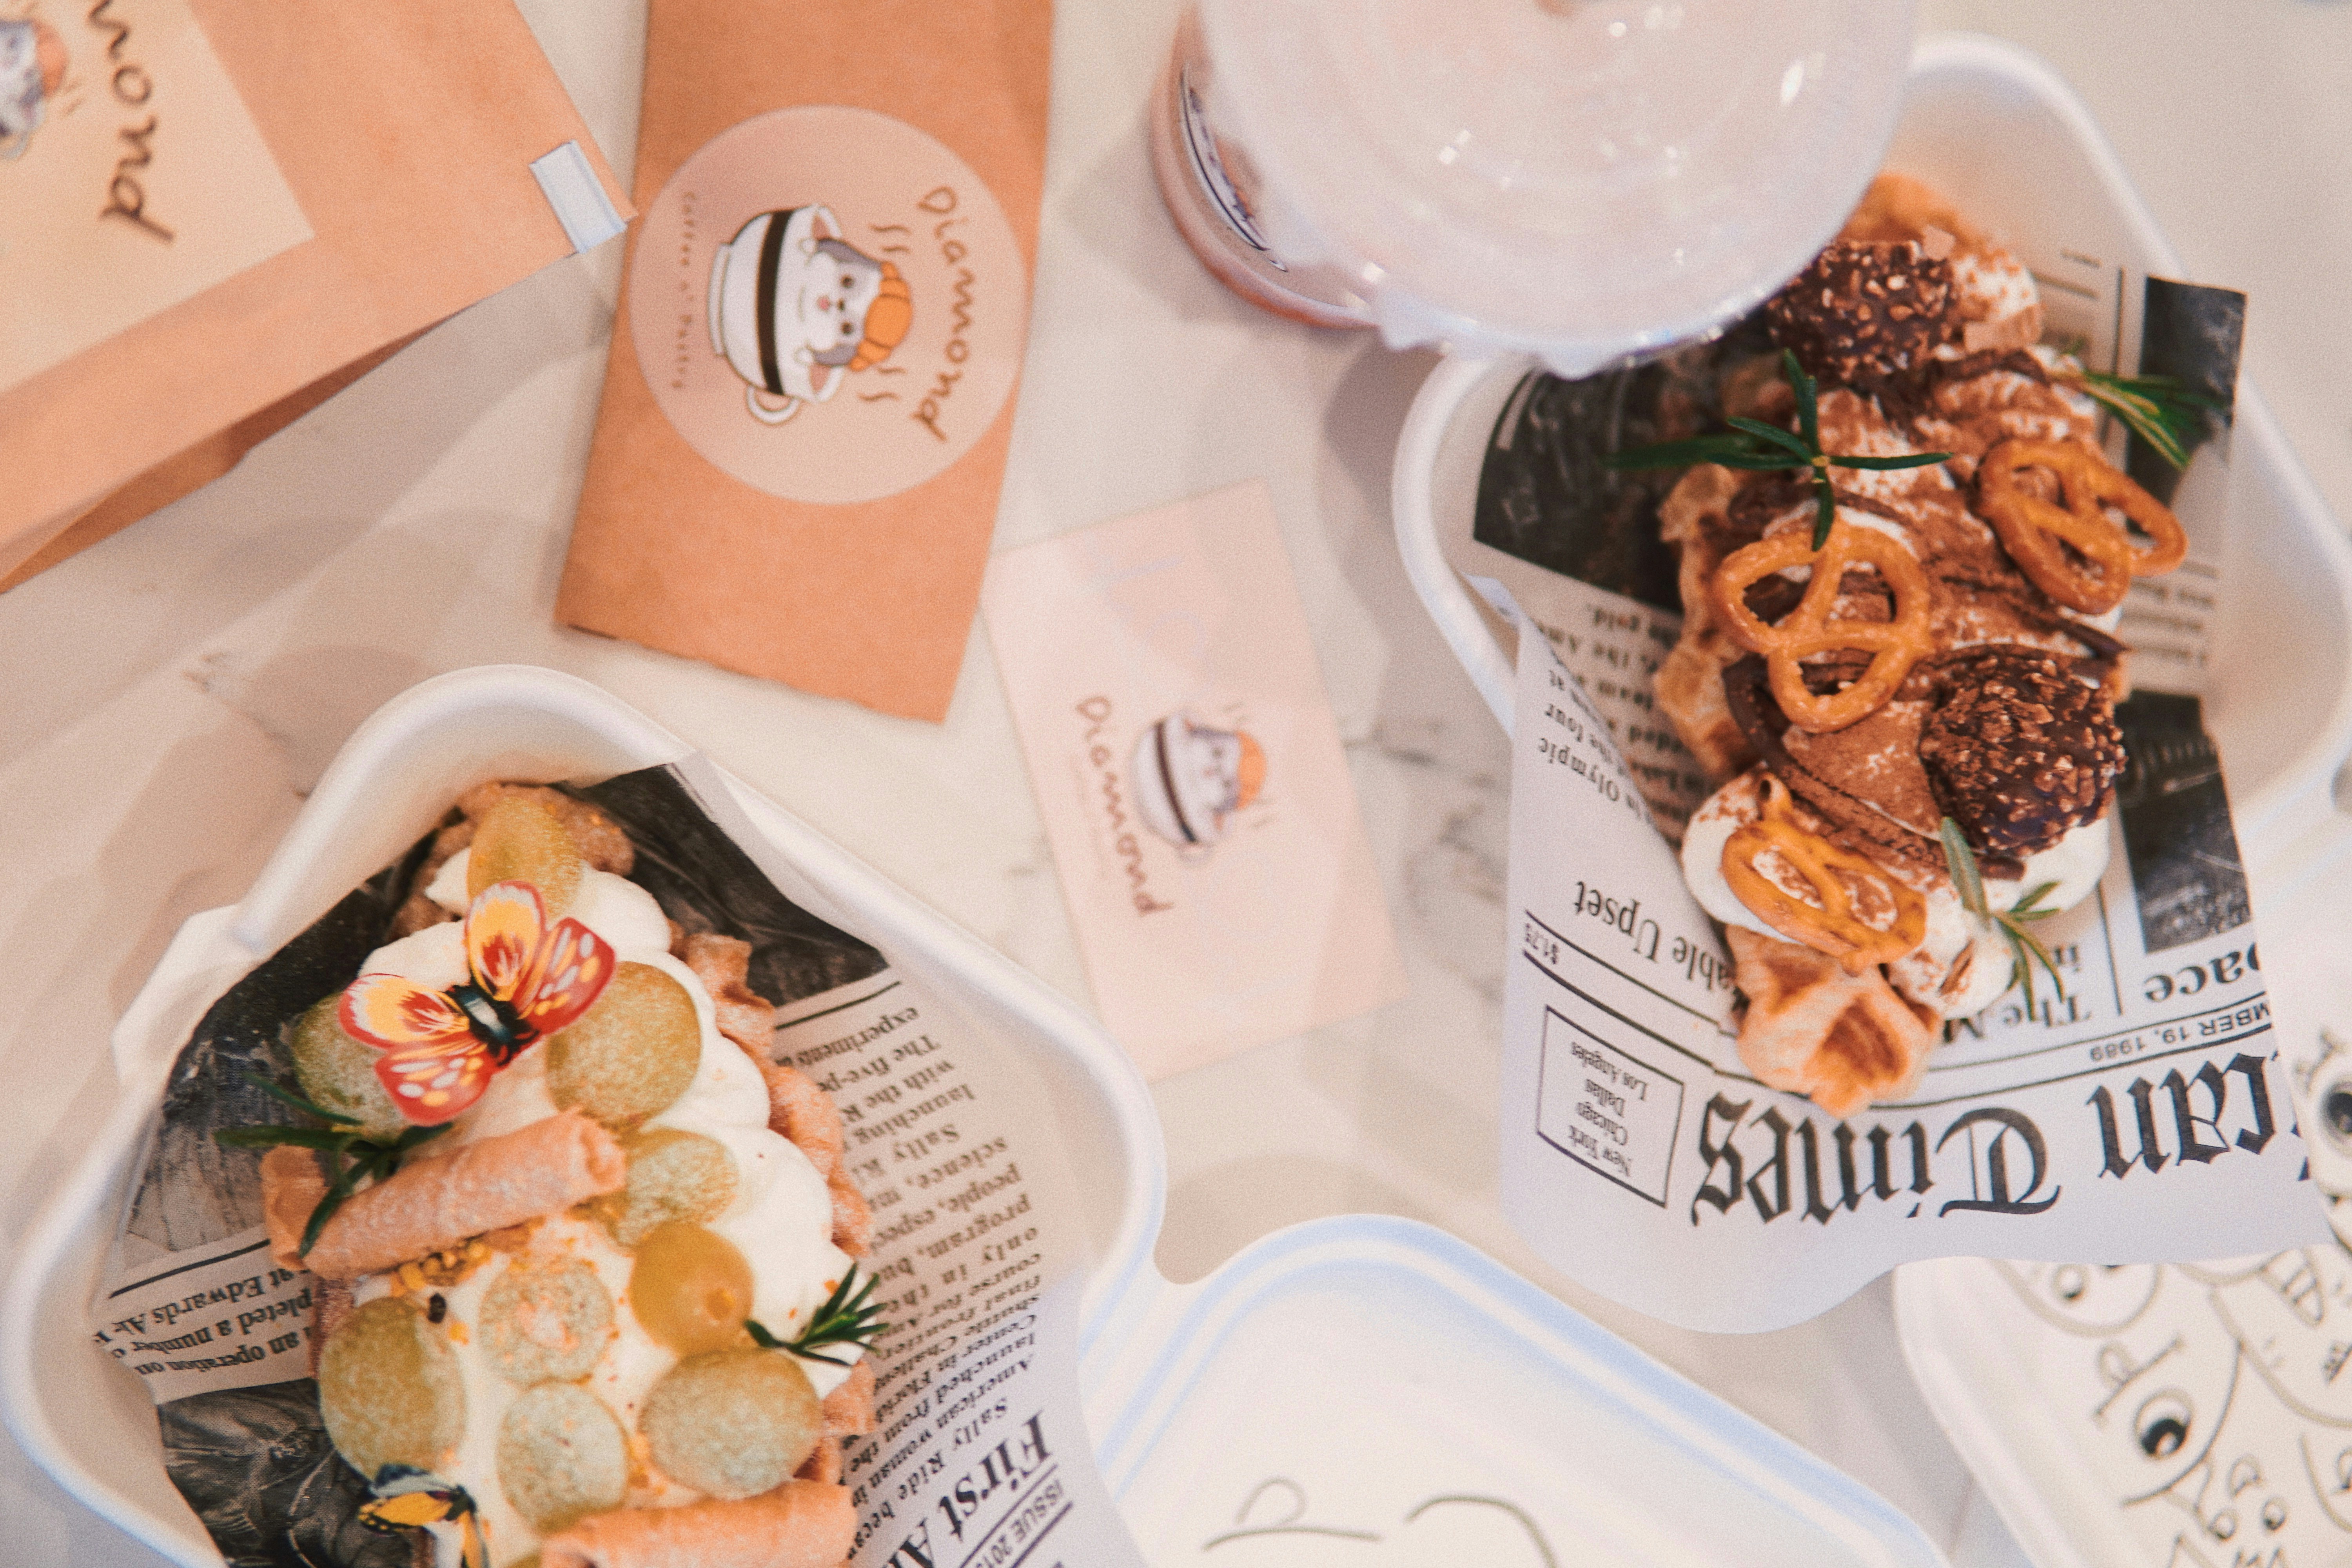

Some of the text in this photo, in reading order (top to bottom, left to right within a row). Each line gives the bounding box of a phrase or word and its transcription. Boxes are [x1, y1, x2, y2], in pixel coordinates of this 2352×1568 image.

[910, 186, 975, 442] Diamond
[1539, 737, 1620, 802] Olympic
[1076, 695, 1176, 917] Diamond
[1573, 881, 1659, 963] Upset
[894, 1034, 941, 1061] The
[2090, 1035, 2146, 1061] 1989
[2155, 1026, 2191, 1044] 19,
[902, 1060, 955, 1090] with
[1572, 1041, 1622, 1083] Angeles
[852, 1083, 975, 1144] launching
[865, 1084, 902, 1109] the
[1585, 1078, 1625, 1117] Dallas
[894, 1123, 960, 1163] Sally
[1576, 1101, 1629, 1145] Chicago
[1691, 1051, 2305, 1226] can Times
[906, 1136, 1007, 1189] science,
[937, 1161, 1021, 1212] people,
[983, 1227, 1038, 1265] only
[942, 1263, 968, 1285] in
[153, 1275, 266, 1325] Edwards
[130, 1327, 212, 1354] number
[216, 1319, 232, 1336] a
[268, 1332, 300, 1354] an
[962, 1314, 1037, 1357] Center
[165, 1343, 266, 1372] operation
[936, 1333, 1035, 1404] launched
[936, 1353, 1034, 1429] American
[883, 1398, 931, 1443] from
[953, 1397, 1008, 1451] Sally
[868, 1428, 932, 1488] woman
[898, 1452, 945, 1501] Ride
[939, 1408, 1052, 1543] First
[975, 1479, 1064, 1568] ISSUE 201
